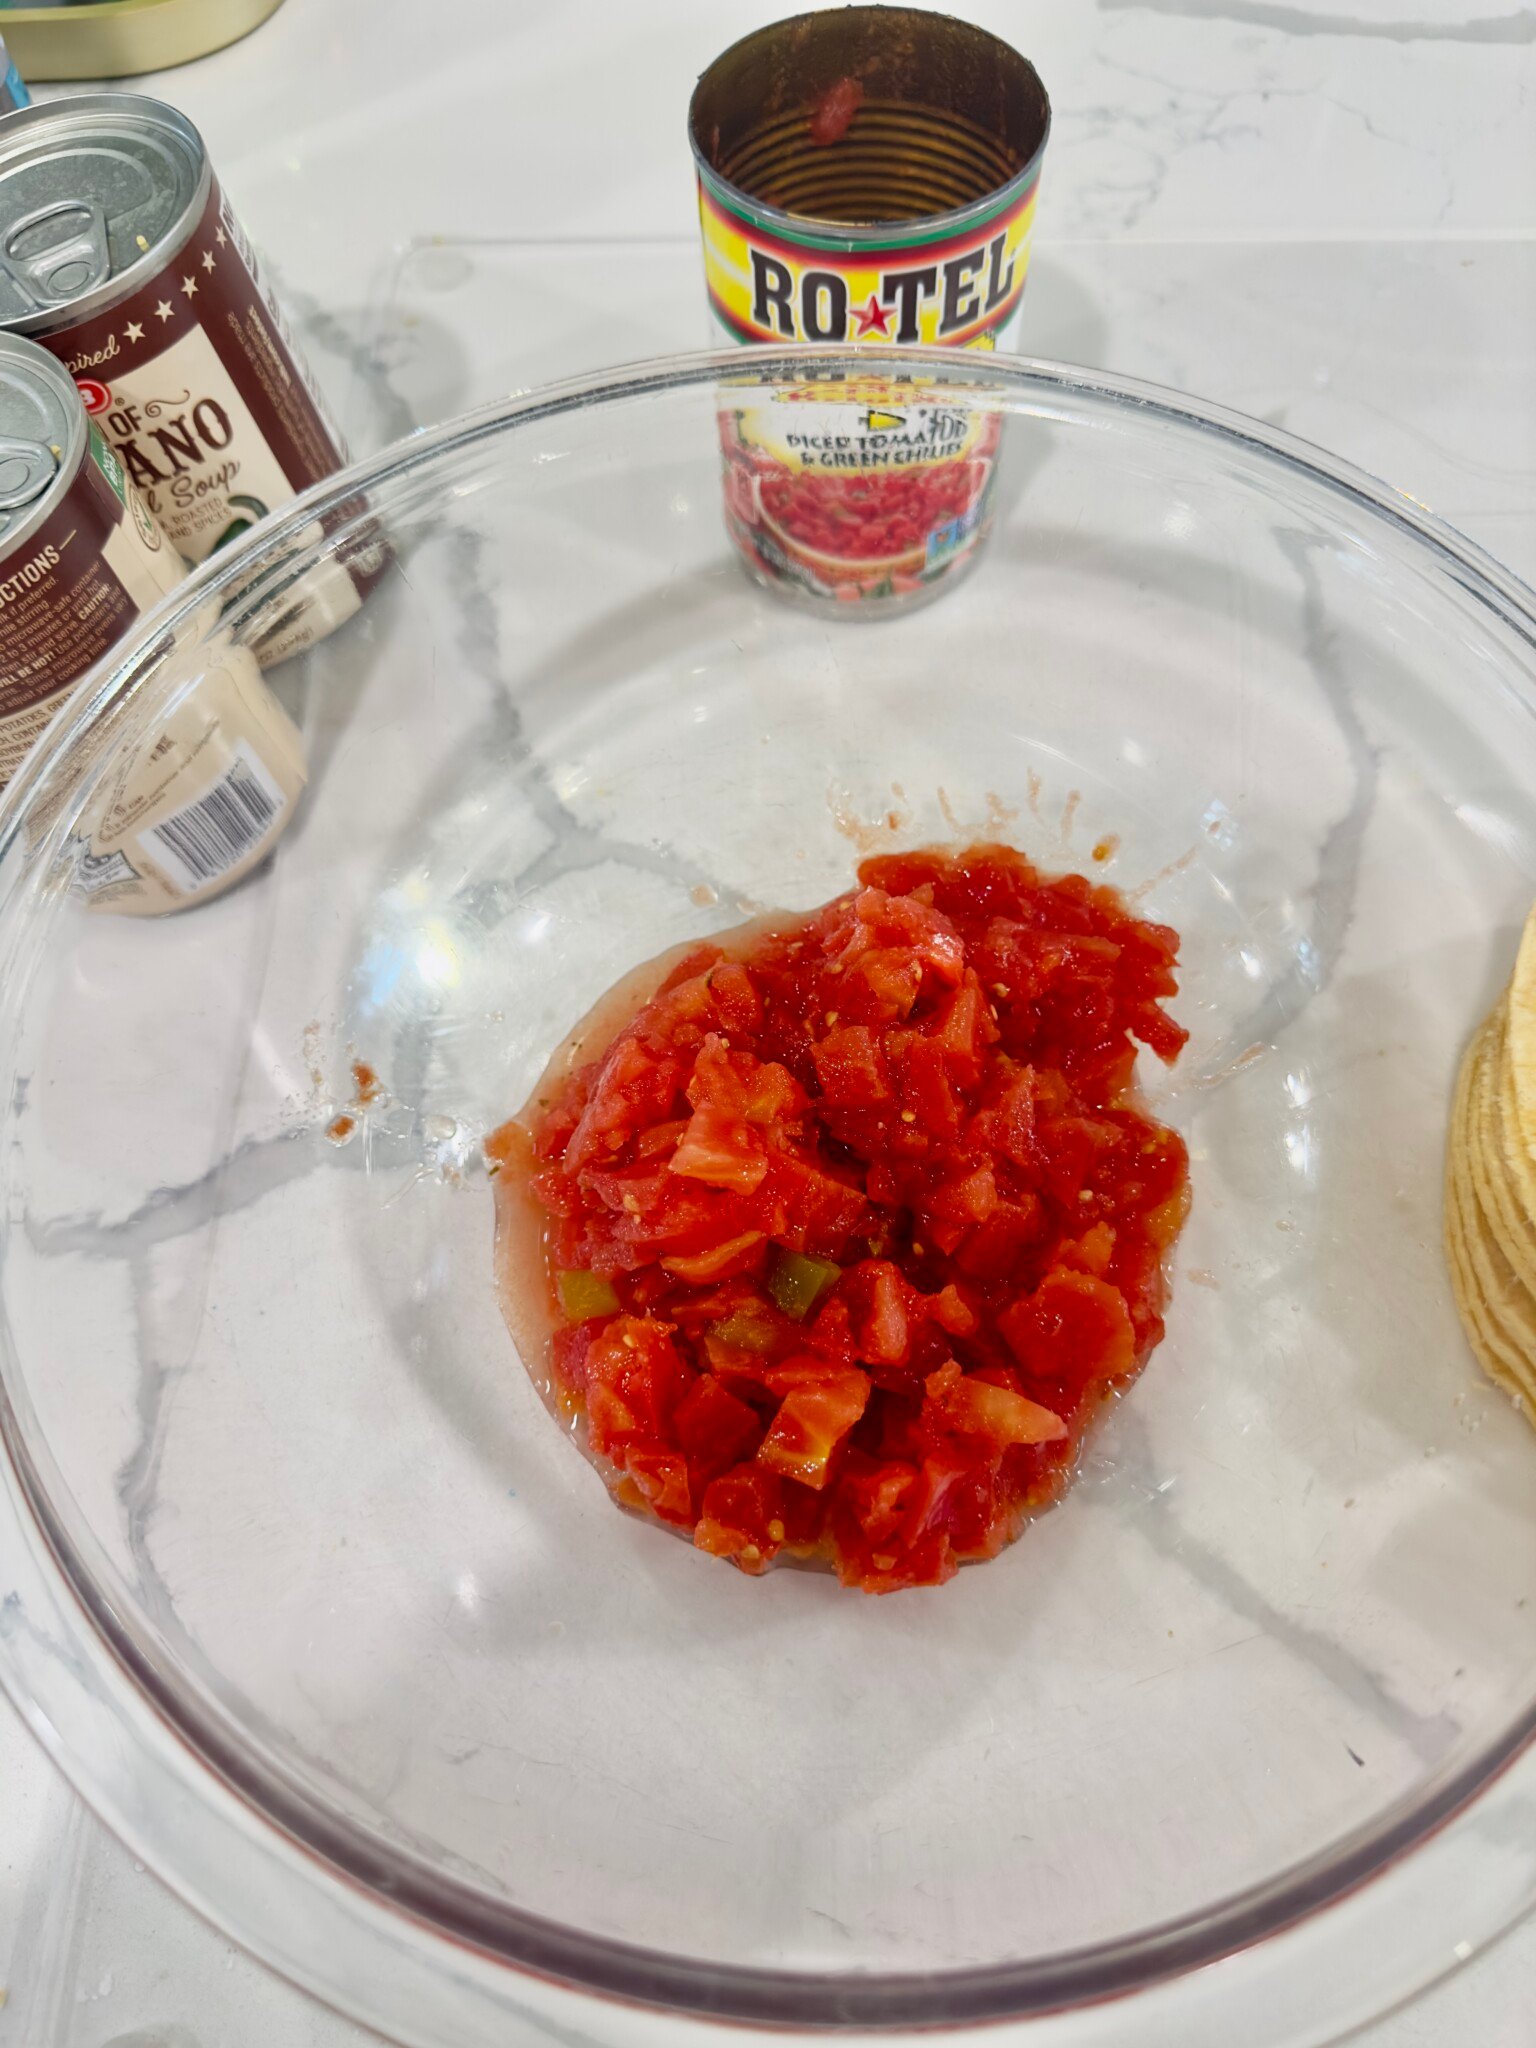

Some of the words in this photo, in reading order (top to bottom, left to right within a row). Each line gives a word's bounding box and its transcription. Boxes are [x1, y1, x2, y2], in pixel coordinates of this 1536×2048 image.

[108, 406, 142, 437] OF
[786, 434, 850, 451] DICED
[801, 453, 814, 466] &
[820, 452, 890, 468] GREEN
[170, 462, 240, 508] Soup
[19, 643, 28, 652] 3
[28, 619, 63, 647] minutes
[61, 610, 72, 621] or
[71, 591, 89, 613] until
[38, 637, 56, 654] and
[78, 583, 112, 620] CAUTION:
[17, 666, 34, 678] BE
[32, 651, 57, 670] HOT!
[55, 639, 74, 655] Use
